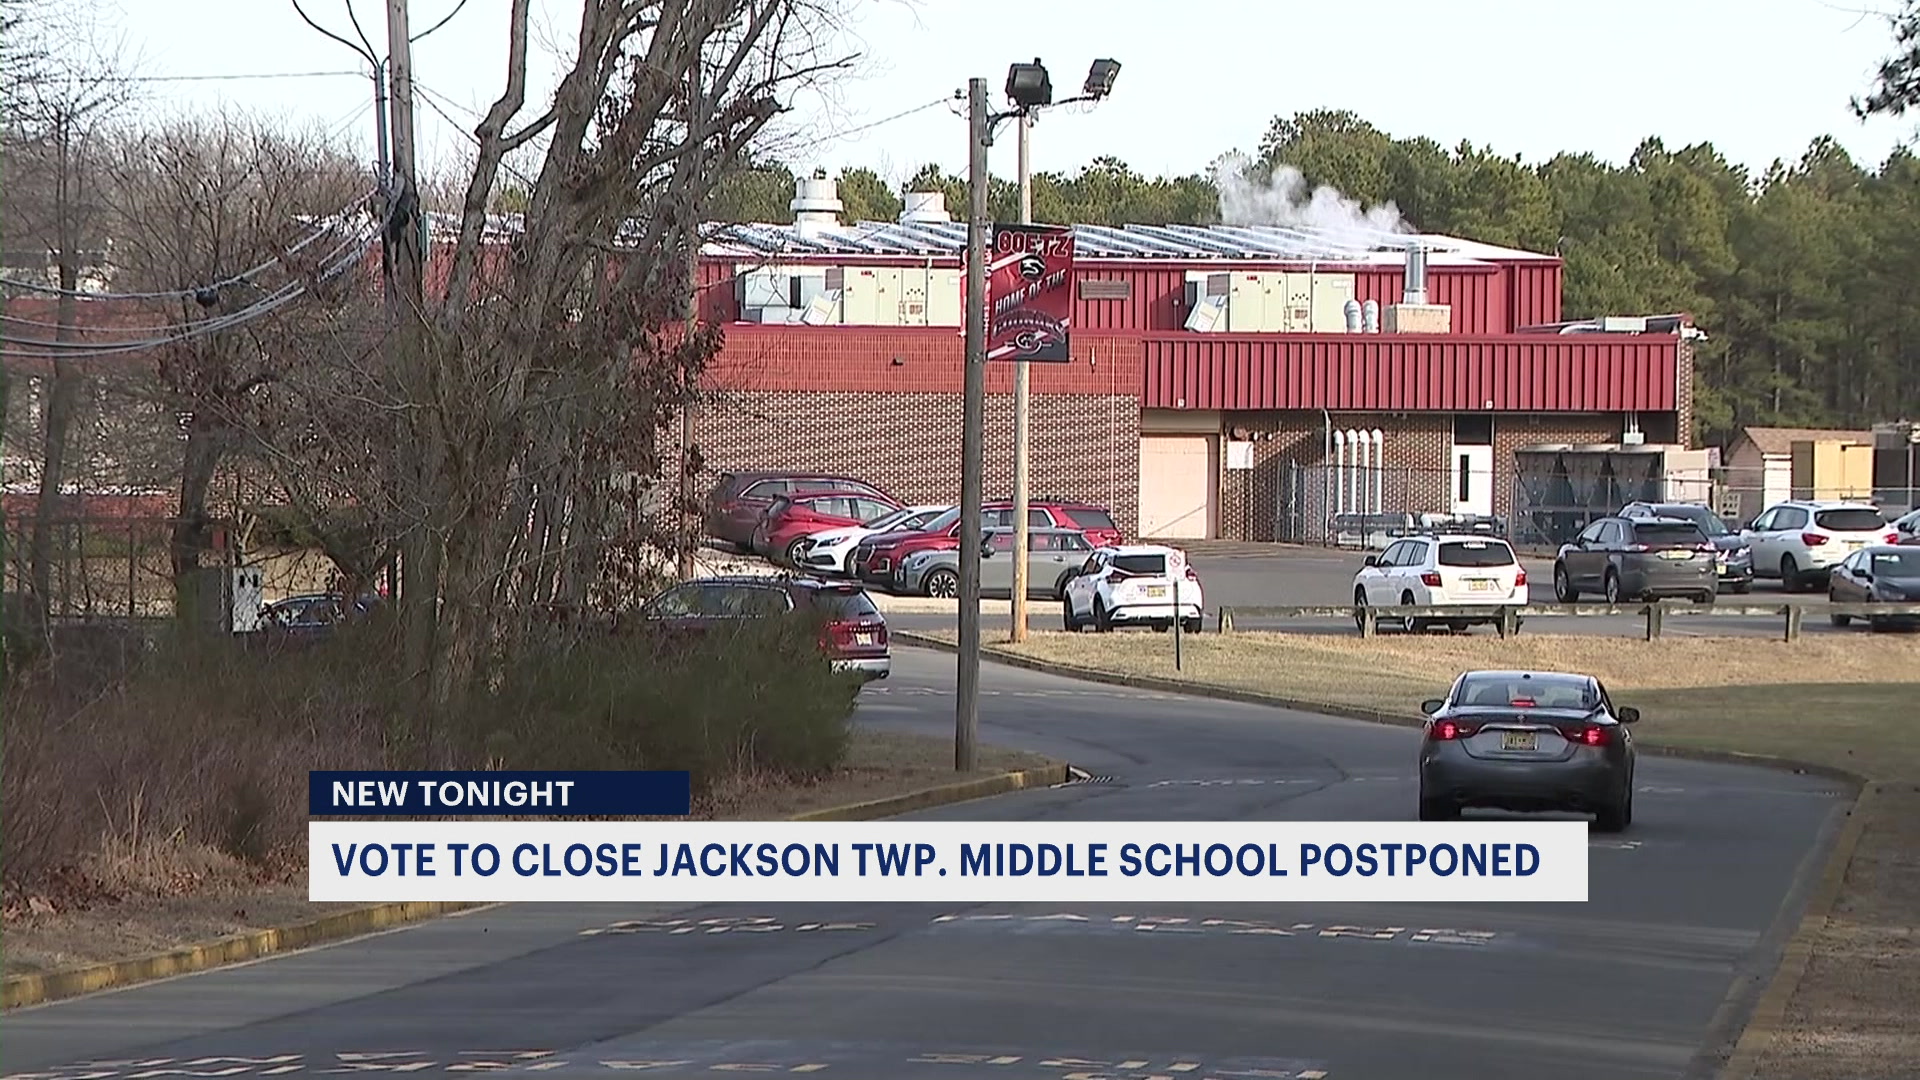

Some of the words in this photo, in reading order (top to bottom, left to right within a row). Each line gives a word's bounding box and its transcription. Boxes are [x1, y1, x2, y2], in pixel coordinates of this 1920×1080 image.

[997, 230, 1069, 257] GOETZ
[995, 287, 1025, 314] HOME
[1028, 281, 1042, 299] OF
[1045, 268, 1067, 291] THE
